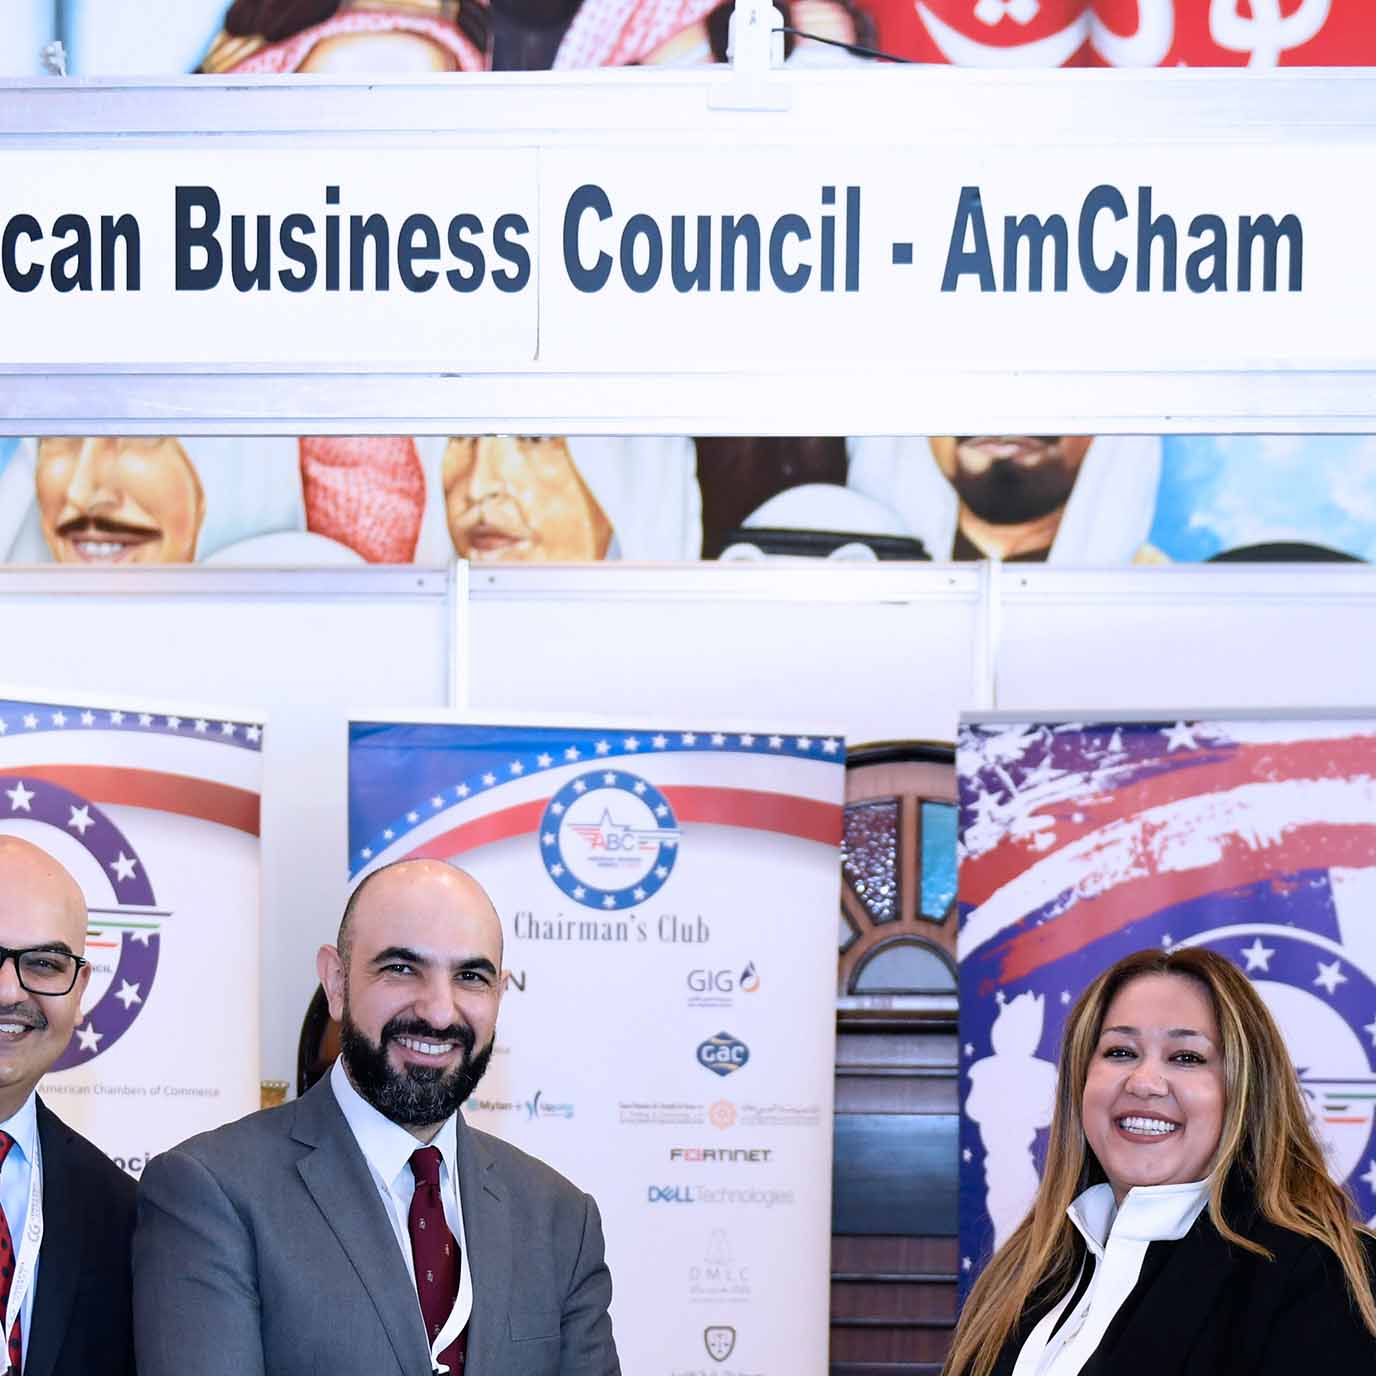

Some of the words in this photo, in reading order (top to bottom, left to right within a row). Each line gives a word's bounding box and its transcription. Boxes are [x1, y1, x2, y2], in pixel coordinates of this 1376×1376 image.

[174, 185, 531, 293] Business
[562, 183, 861, 293] Council
[892, 242, 912, 264] -
[940, 184, 1304, 293] AmCham
[513, 911, 648, 942] Chairman's
[658, 914, 711, 944] Club
[687, 969, 734, 993] GIG
[37, 1083, 91, 1096] American
[94, 1083, 148, 1097] Chambers
[149, 1084, 162, 1097] of
[164, 1085, 221, 1098] Commerce
[670, 1148, 773, 1162] FORTINET
[647, 1185, 695, 1203] DELL
